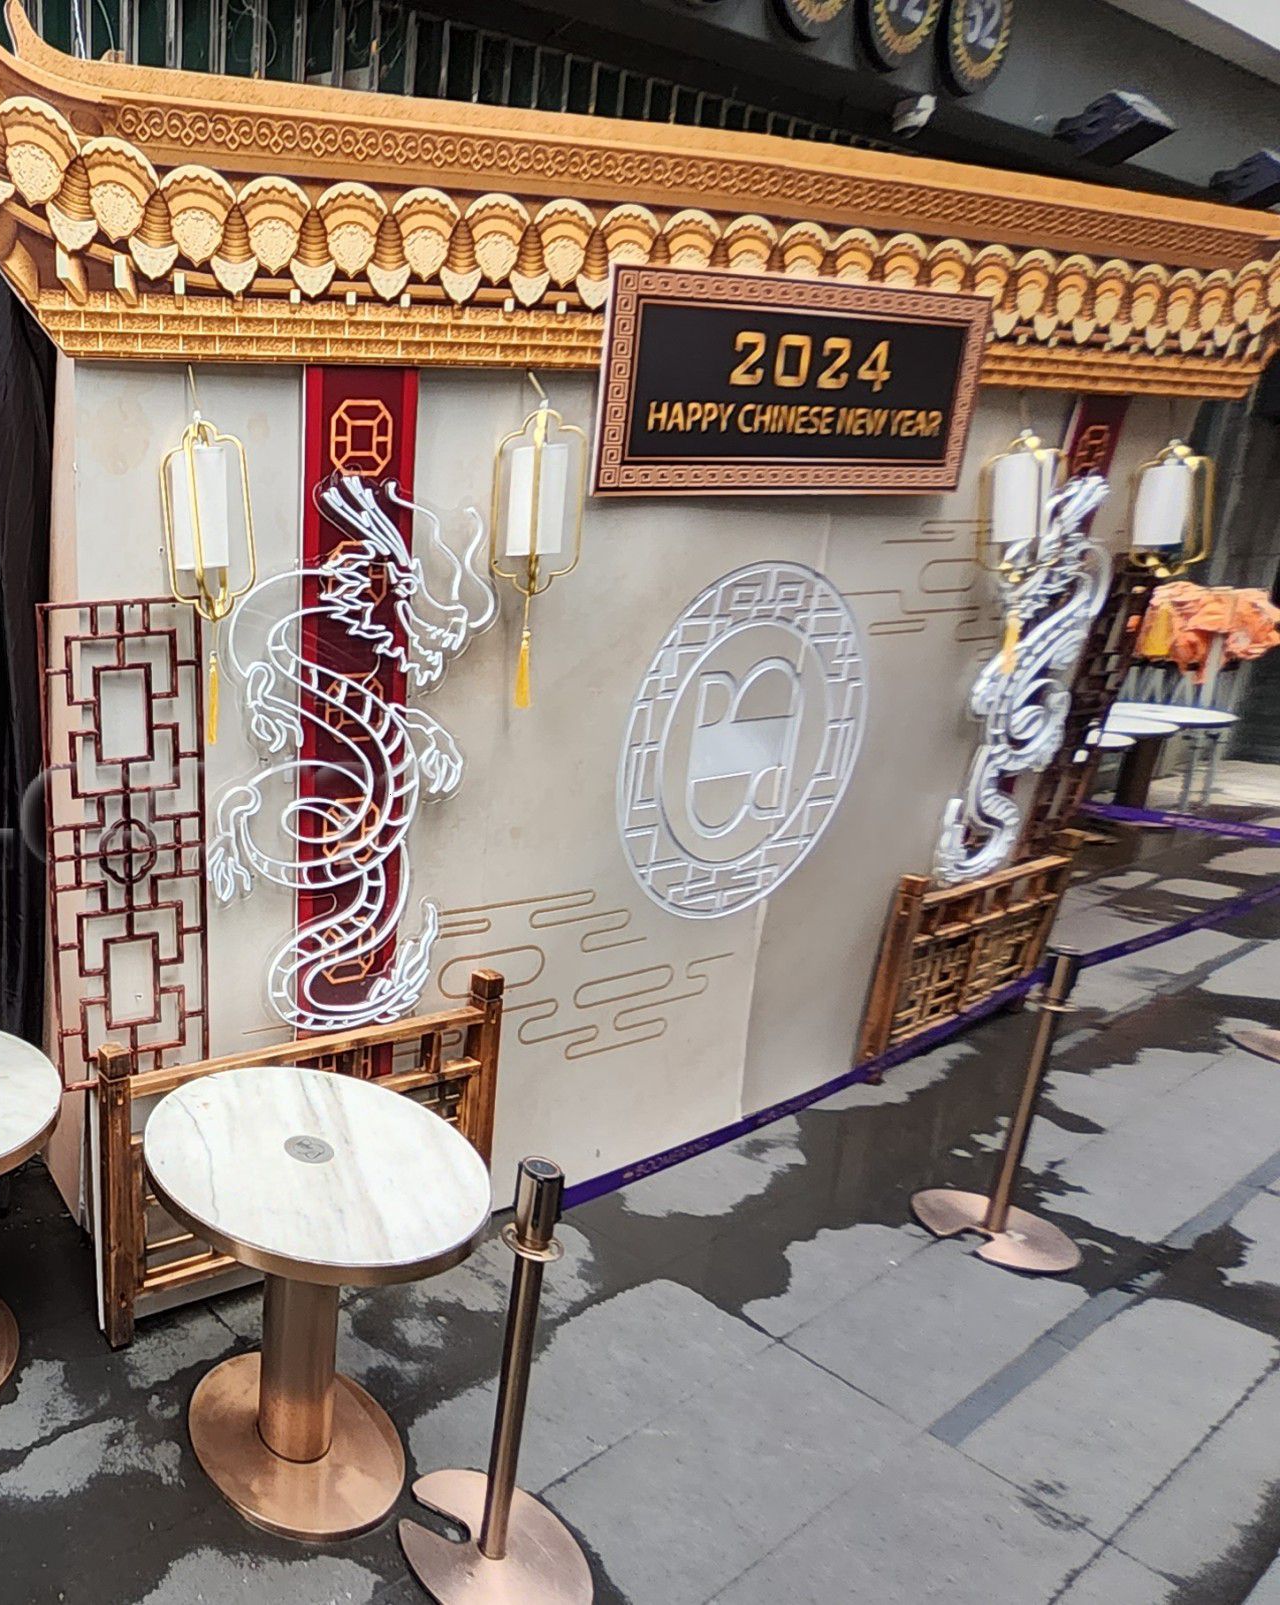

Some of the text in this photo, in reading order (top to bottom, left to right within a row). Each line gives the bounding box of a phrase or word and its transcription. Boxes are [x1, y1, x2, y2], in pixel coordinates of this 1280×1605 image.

[729, 331, 892, 392] 2024
[647, 401, 943, 438] HAPPY CHINESE NEW YEAR
